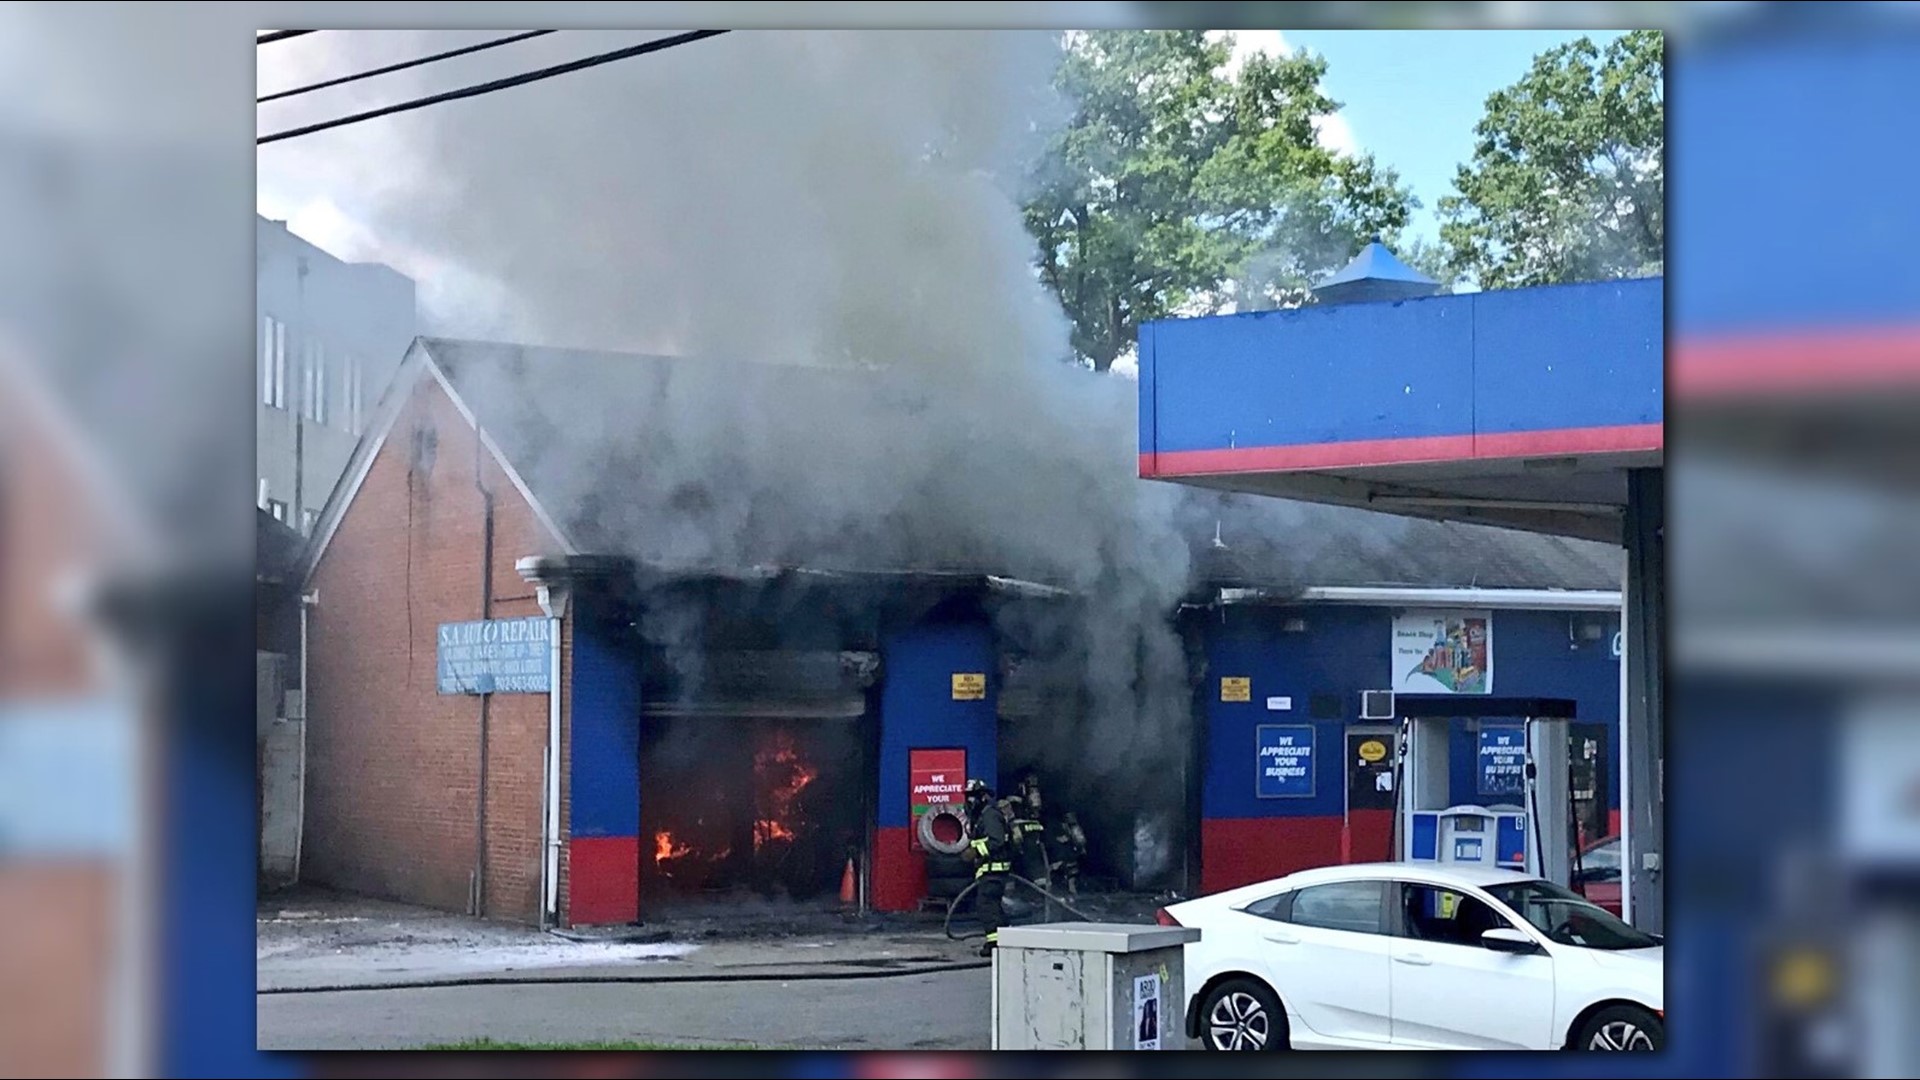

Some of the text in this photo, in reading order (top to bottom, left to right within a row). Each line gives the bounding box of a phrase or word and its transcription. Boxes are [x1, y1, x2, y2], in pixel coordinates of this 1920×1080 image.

[501, 620, 549, 642] REPAIR
[1279, 736, 1293, 746] WE
[1260, 746, 1311, 757] APPRECIATE
[1274, 757, 1298, 766] YOUR
[1265, 766, 1306, 777] BUSINESS
[931, 774, 945, 783] WE
[913, 784, 963, 794] APPRECIATE
[926, 795, 950, 803] YOUR
